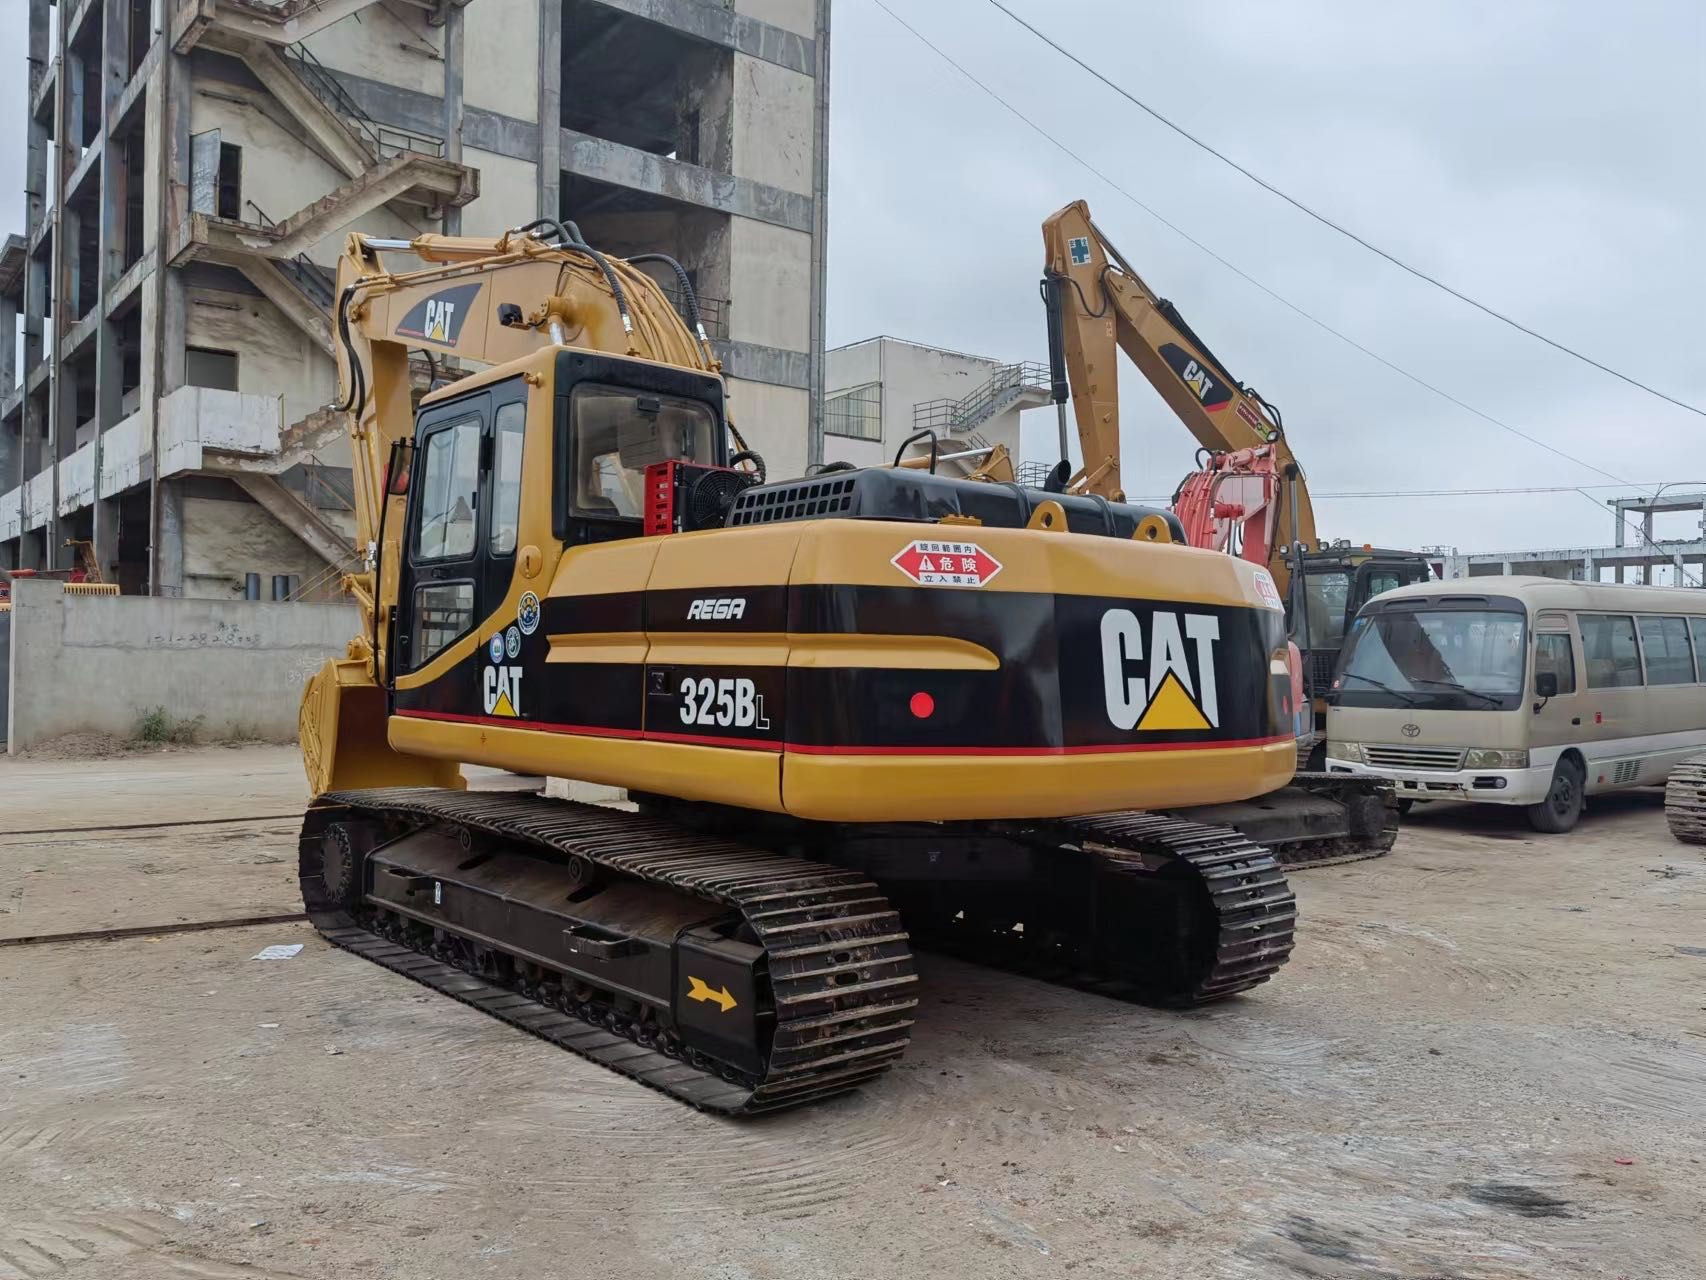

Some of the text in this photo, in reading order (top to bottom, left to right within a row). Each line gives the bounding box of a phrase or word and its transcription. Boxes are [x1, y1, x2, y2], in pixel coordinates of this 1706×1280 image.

[424, 299, 455, 343] CAT
[1183, 360, 1214, 400] CAT
[924, 575, 976, 585] 立入禁止
[686, 598, 747, 620] REGA
[1100, 608, 1221, 730] CAT
[483, 665, 524, 717] CAT
